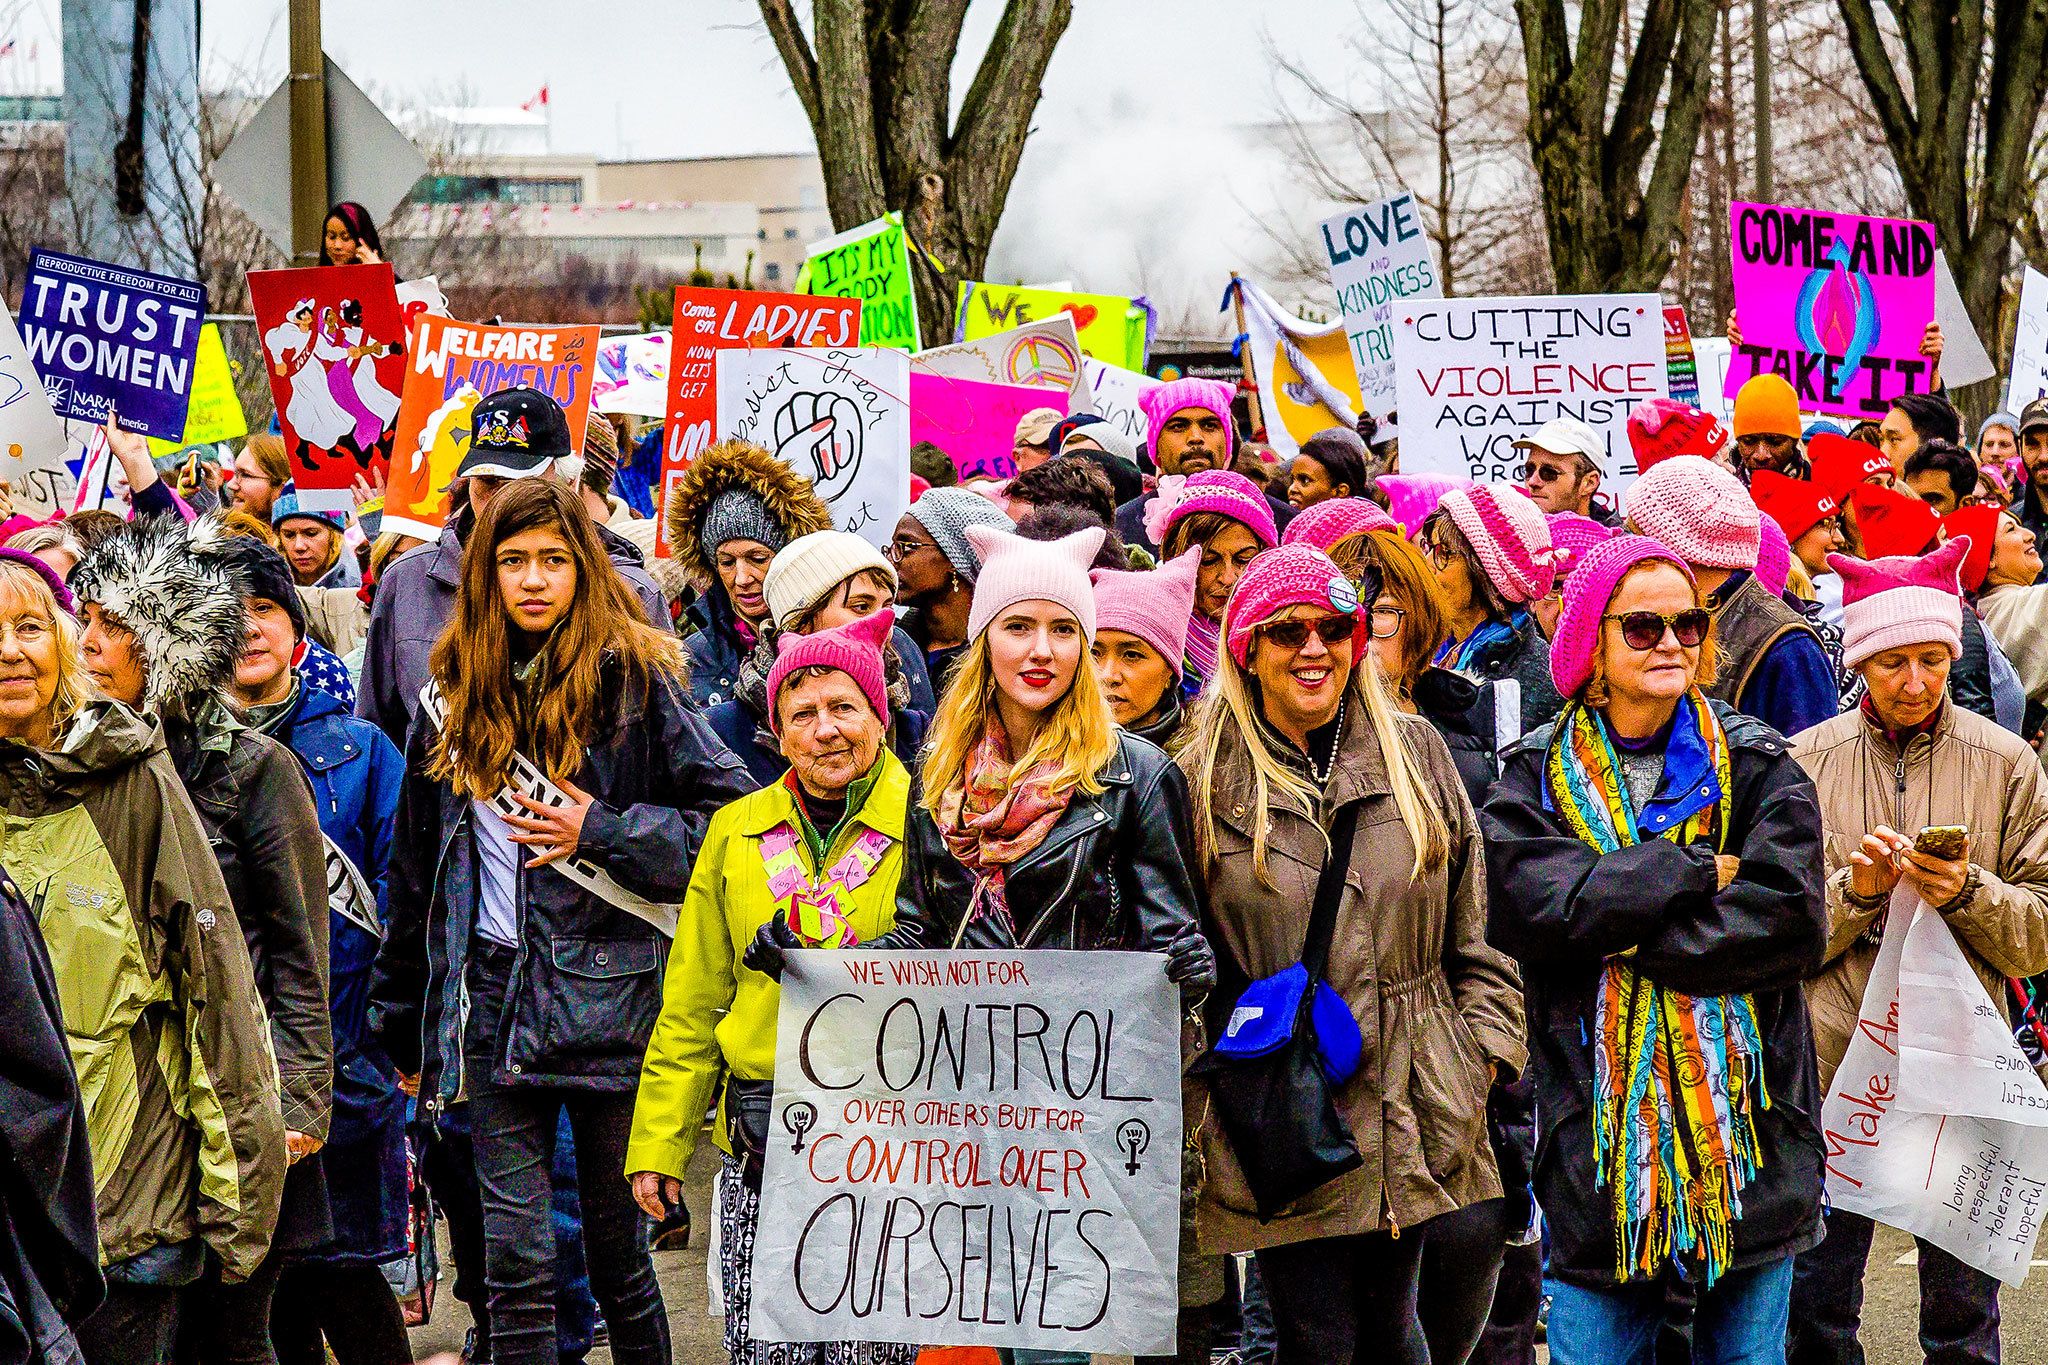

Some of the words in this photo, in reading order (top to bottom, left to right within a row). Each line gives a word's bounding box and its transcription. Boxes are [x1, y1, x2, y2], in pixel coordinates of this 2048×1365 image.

[869, 233, 898, 270] MY
[1321, 194, 1419, 266] LOVE
[1739, 208, 1835, 271] COME
[1850, 221, 1935, 278] AND
[39, 257, 106, 280] REPRODUCTIVE
[109, 272, 155, 290] FREEDOM
[157, 283, 177, 295] FOR
[178, 288, 197, 300] ALL
[1369, 256, 1391, 271] AND
[682, 301, 716, 318] Come
[981, 290, 1033, 327] WE
[1336, 260, 1433, 316] KINDNESS
[32, 275, 197, 349] TRUST
[695, 319, 716, 334] on
[719, 301, 853, 347] LADIES
[861, 295, 913, 342] TION
[1416, 307, 1632, 342] CUTTING
[24, 324, 189, 395] WOMEN
[415, 323, 557, 378] WELFARE
[563, 333, 585, 349] is
[564, 352, 580, 362] a
[687, 346, 716, 360] NOW
[1490, 341, 1559, 359] THE
[73, 390, 118, 412] NARAL
[443, 358, 583, 409] WOMEN'S
[680, 382, 707, 399] GET
[1417, 363, 1657, 397] VIOLENCE
[1738, 344, 1845, 404] TAKE
[1859, 355, 1925, 414] IT
[70, 405, 108, 421] Pro-Choi
[118, 415, 149, 431] America
[1436, 398, 1643, 429] AGAINST
[844, 960, 884, 986] WE
[889, 960, 943, 986] WISH
[946, 960, 981, 986] NOT
[987, 961, 1030, 986] FOR
[799, 993, 1154, 1102] CONTROL
[843, 1099, 906, 1127] OVER
[913, 1103, 989, 1128] OTHERS
[998, 1105, 1041, 1129] BUT
[1046, 1108, 1085, 1134] FOR
[1824, 1073, 1896, 1189] Make
[808, 1133, 991, 1188] CONTROL
[1000, 1145, 1091, 1198] OVER
[1942, 1164, 1976, 1212] loving
[1968, 1140, 2001, 1223] respectful
[1985, 1160, 2020, 1236] tolerant
[2008, 1177, 2047, 1244] hopeful
[793, 1192, 1113, 1331] OURSELVES
